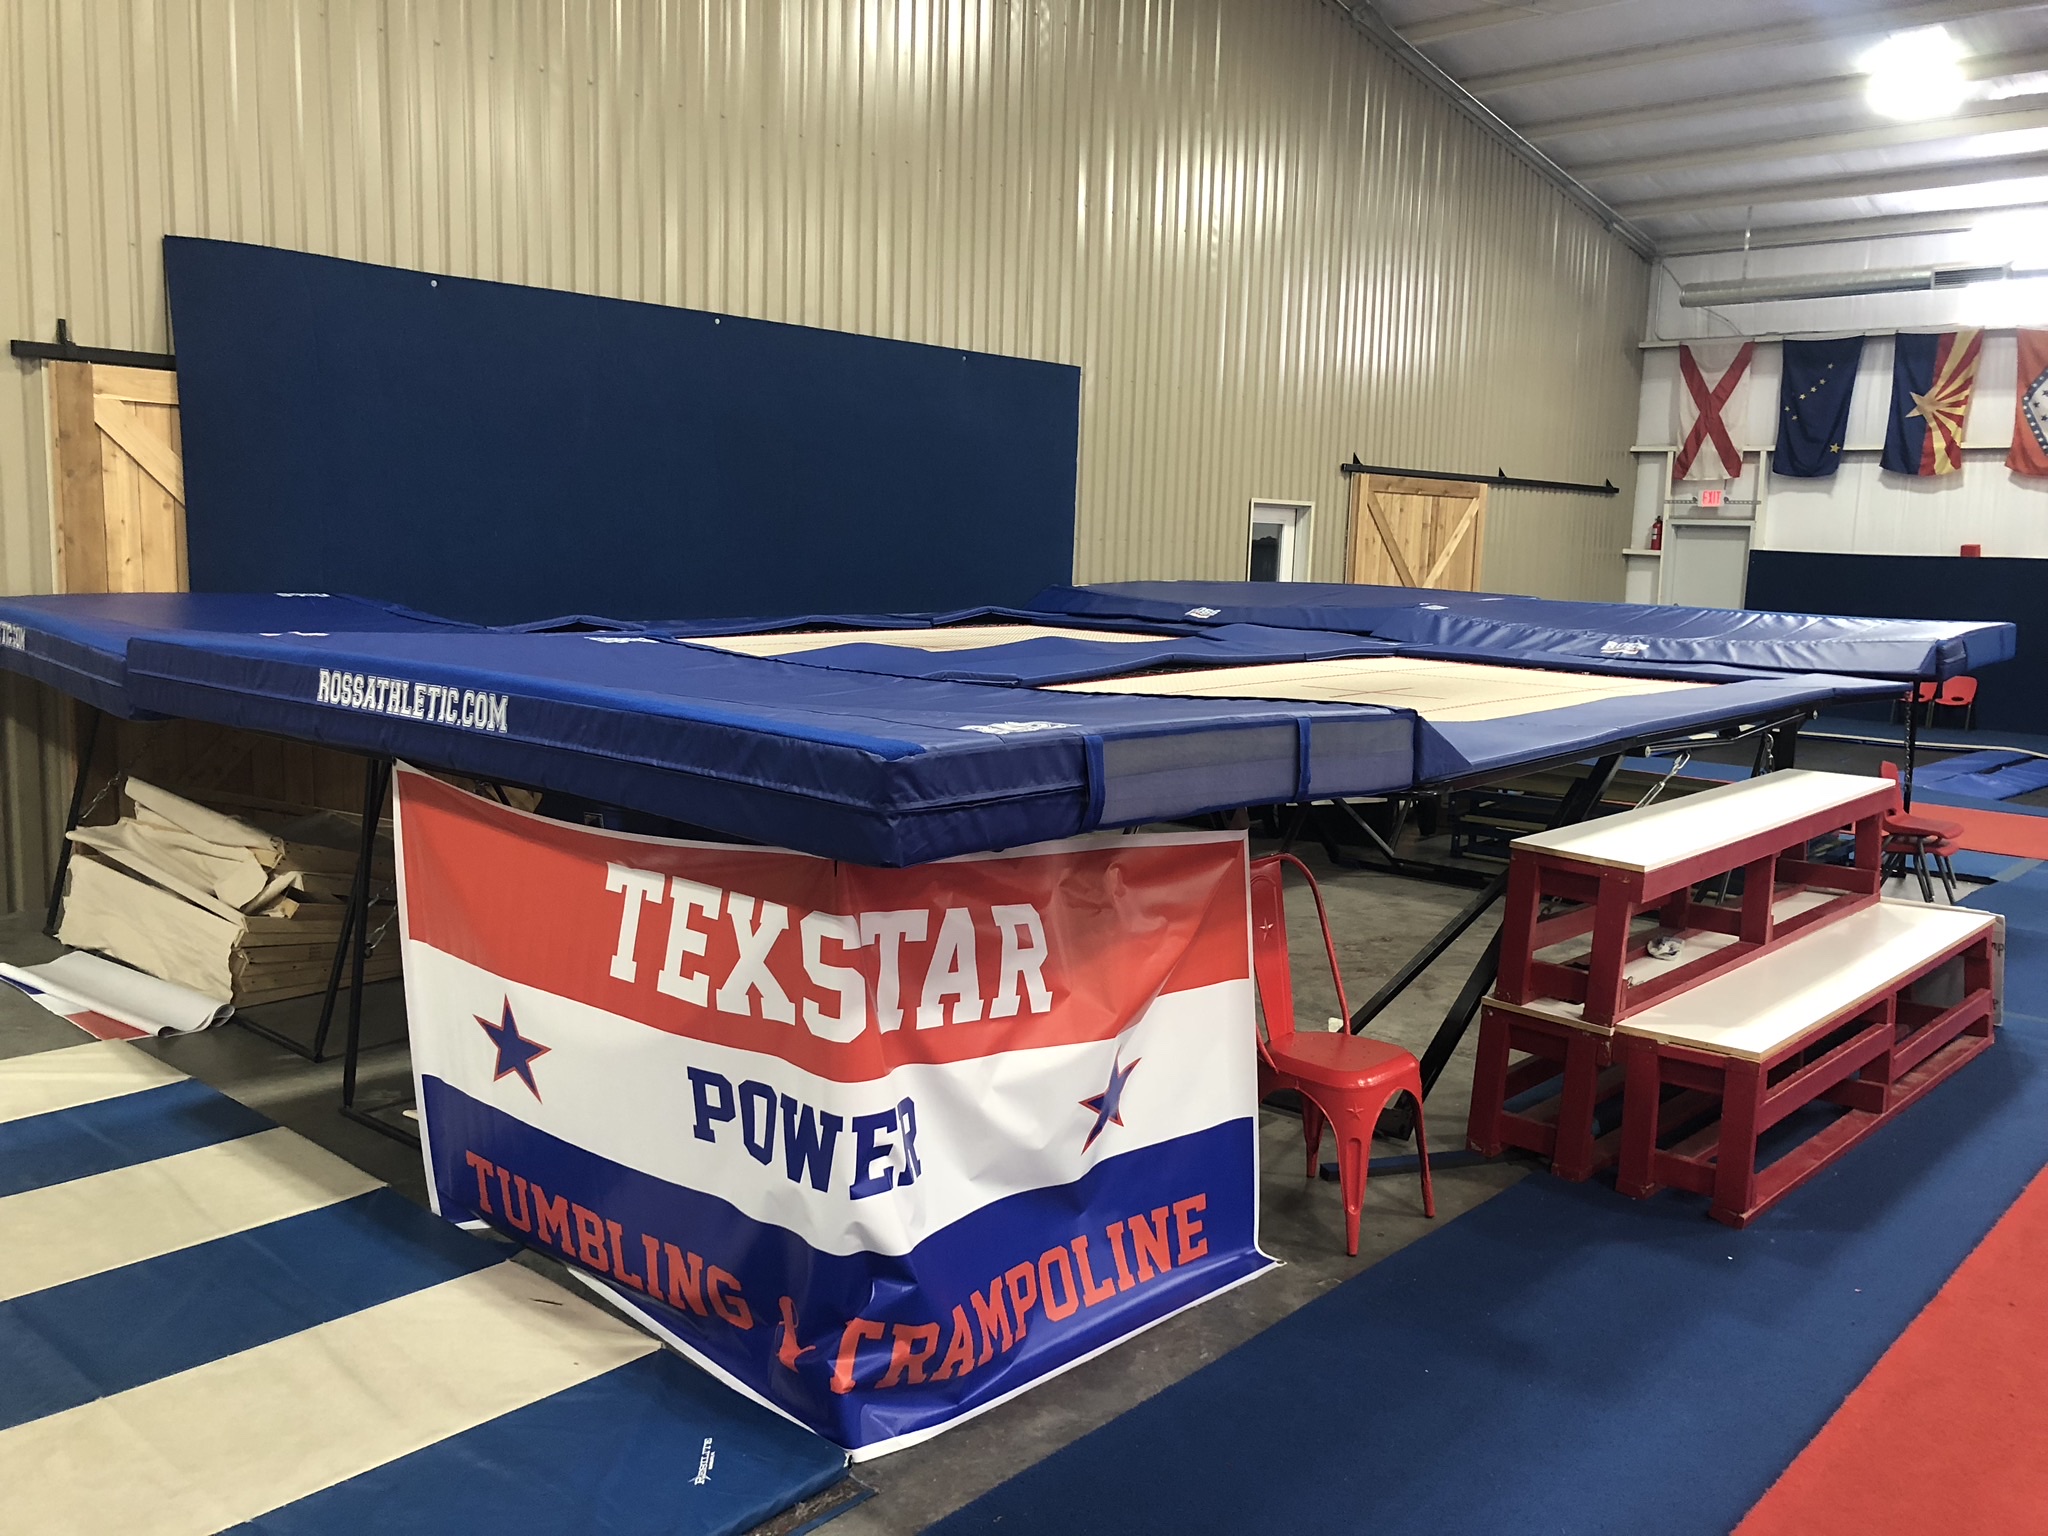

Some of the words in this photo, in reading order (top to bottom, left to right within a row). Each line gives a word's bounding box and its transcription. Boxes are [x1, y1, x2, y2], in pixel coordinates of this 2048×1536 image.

[1702, 490, 1722, 505] EXIT
[317, 668, 509, 734] ROSSATHLETIC.COM
[605, 861, 1053, 1043] TEXSTAR
[687, 1066, 921, 1200] POWER
[466, 1150, 753, 1330] TUMBLING
